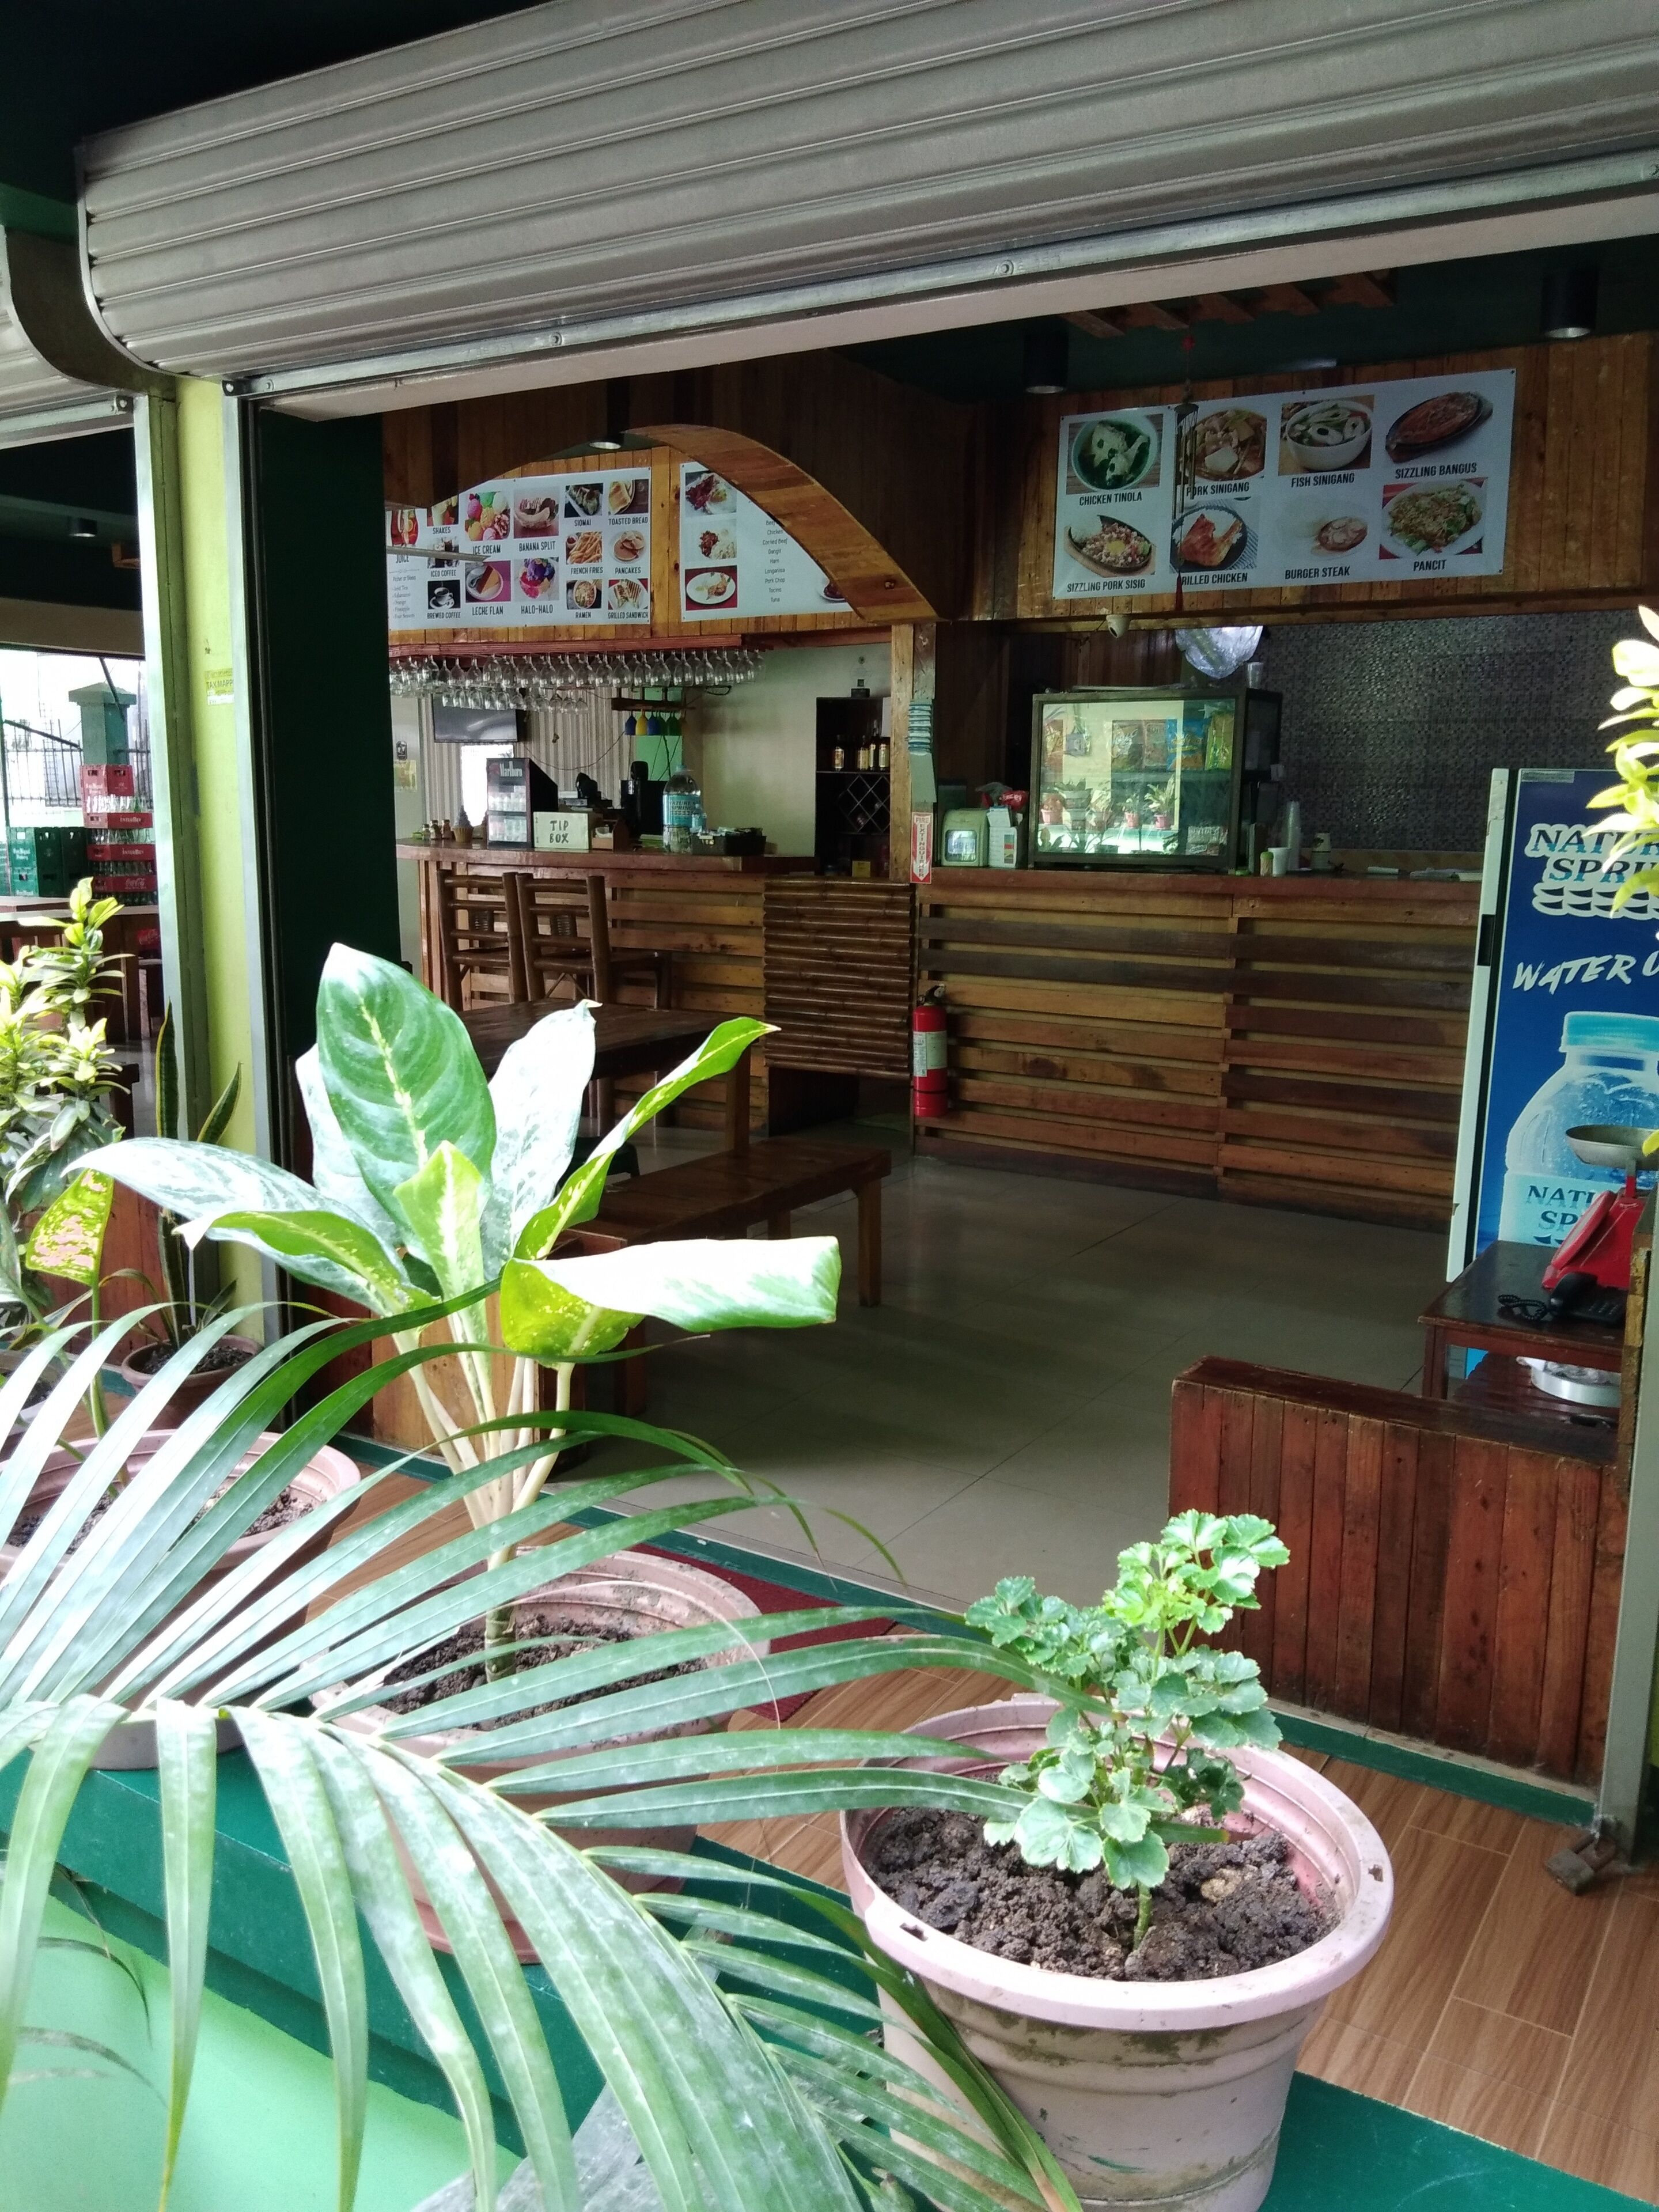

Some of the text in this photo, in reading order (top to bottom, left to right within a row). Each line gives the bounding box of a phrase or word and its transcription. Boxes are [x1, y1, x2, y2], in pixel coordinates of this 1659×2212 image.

[1395, 462, 1478, 479] SIZZLING BANGUS
[1291, 473, 1355, 488] FISH SINIGANG
[1211, 482, 1249, 494] SINIGANG
[1079, 491, 1142, 506] CHICKEN TINOLA
[608, 517, 649, 525] TOASTED BREAD
[433, 527, 451, 535] SHAKES
[472, 545, 501, 555] ICE CREAM
[519, 541, 556, 552] BANANA SPLIT
[1413, 559, 1447, 571] PANCIT
[1285, 566, 1350, 579] BURGER STEAK
[1067, 578, 1146, 592] SIZZLING PORK SISIG
[1181, 573, 1248, 585] RILLED CHICKEN
[472, 606, 503, 615] LECHE FLAN
[521, 604, 554, 614] HALO-HALO
[499, 760, 522, 777] Marlboro
[550, 820, 569, 831] TIP
[549, 833, 569, 844] BOX
[1512, 954, 1637, 995] WATER
